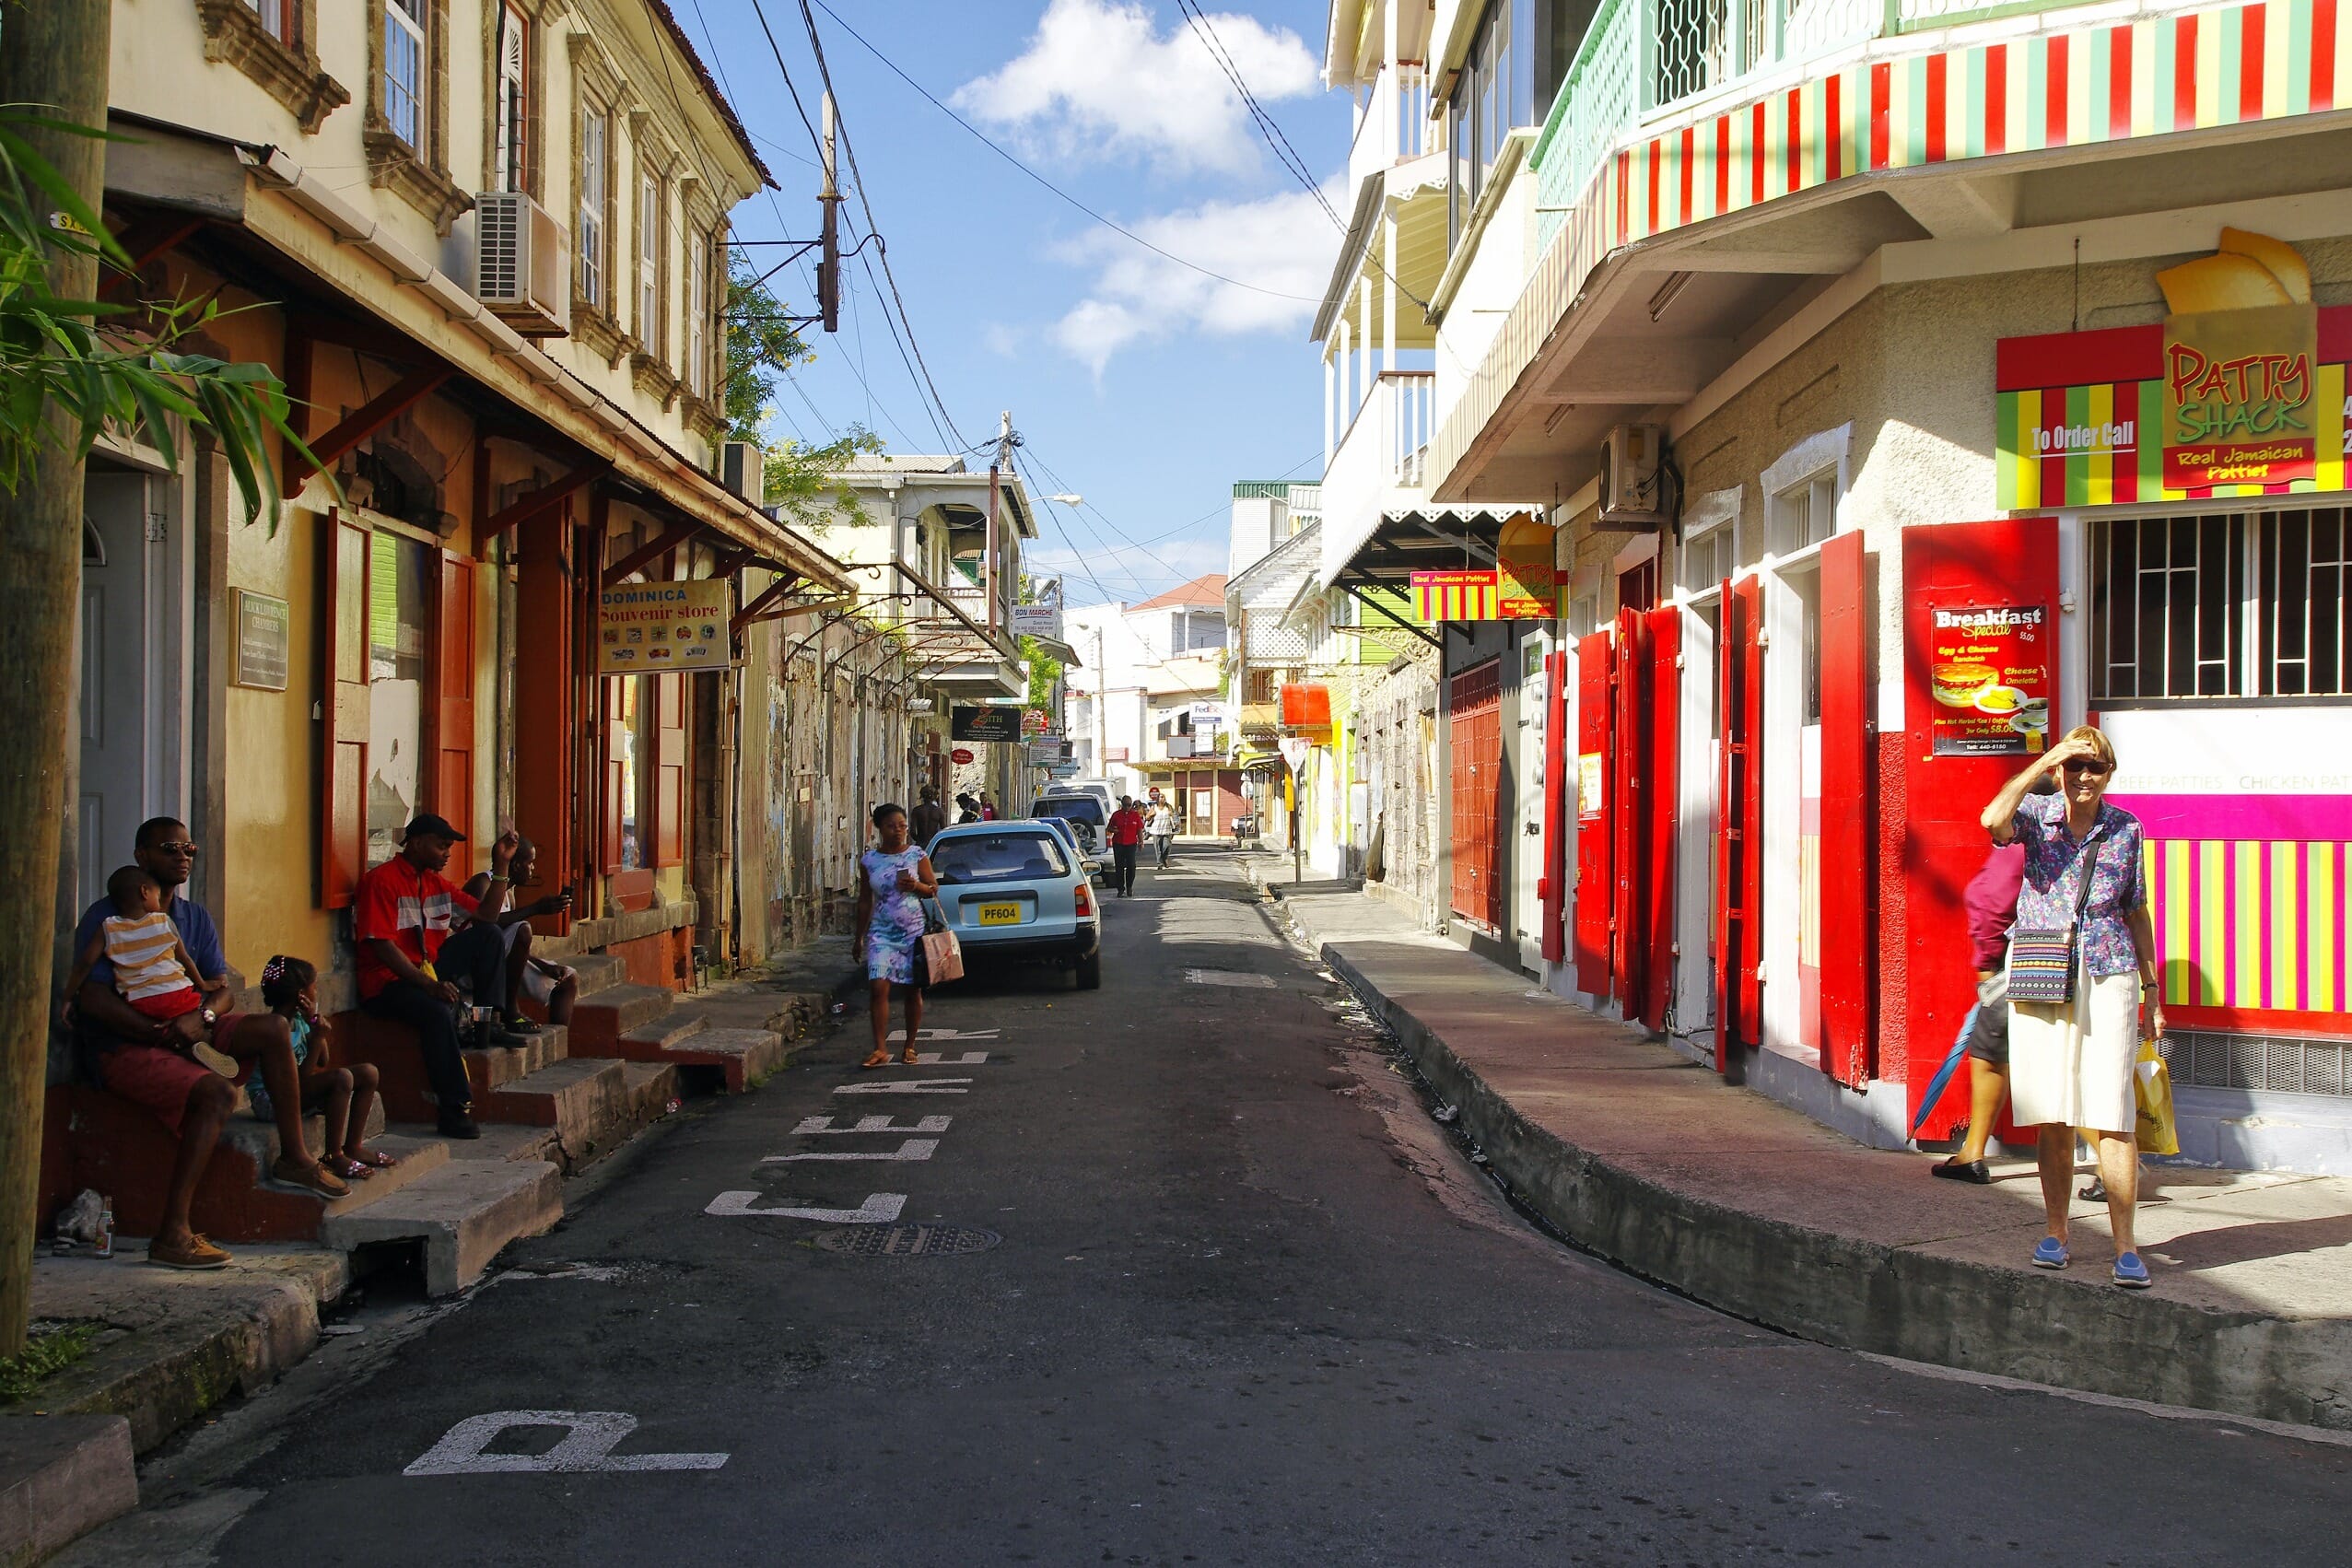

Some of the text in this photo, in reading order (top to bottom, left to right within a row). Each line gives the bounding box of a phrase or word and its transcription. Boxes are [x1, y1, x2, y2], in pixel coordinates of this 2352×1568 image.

[2167, 342, 2311, 407] PATTY
[2176, 398, 2307, 443] SHACK
[2031, 420, 2134, 451] To Order Call
[2176, 446, 2303, 465] Real Jamaican
[2206, 463, 2269, 480] Patties
[1432, 575, 1464, 583] Jamaican
[1498, 556, 1552, 587] PATTY
[602, 590, 687, 605] DOMINICA
[601, 604, 719, 623] Souvenir store
[1936, 608, 2042, 627] Breakfast
[1960, 622, 2012, 641] Special
[1938, 647, 1956, 656] Egg
[1967, 646, 1999, 654] Cheese
[1953, 655, 1986, 663] Sandwich
[1195, 705, 1218, 714] FedEx
[2118, 776, 2154, 790] BEEF
[2161, 776, 2223, 790] PATTIES
[2240, 775, 2314, 790] CHICKEN
[984, 907, 1016, 919] PF604
